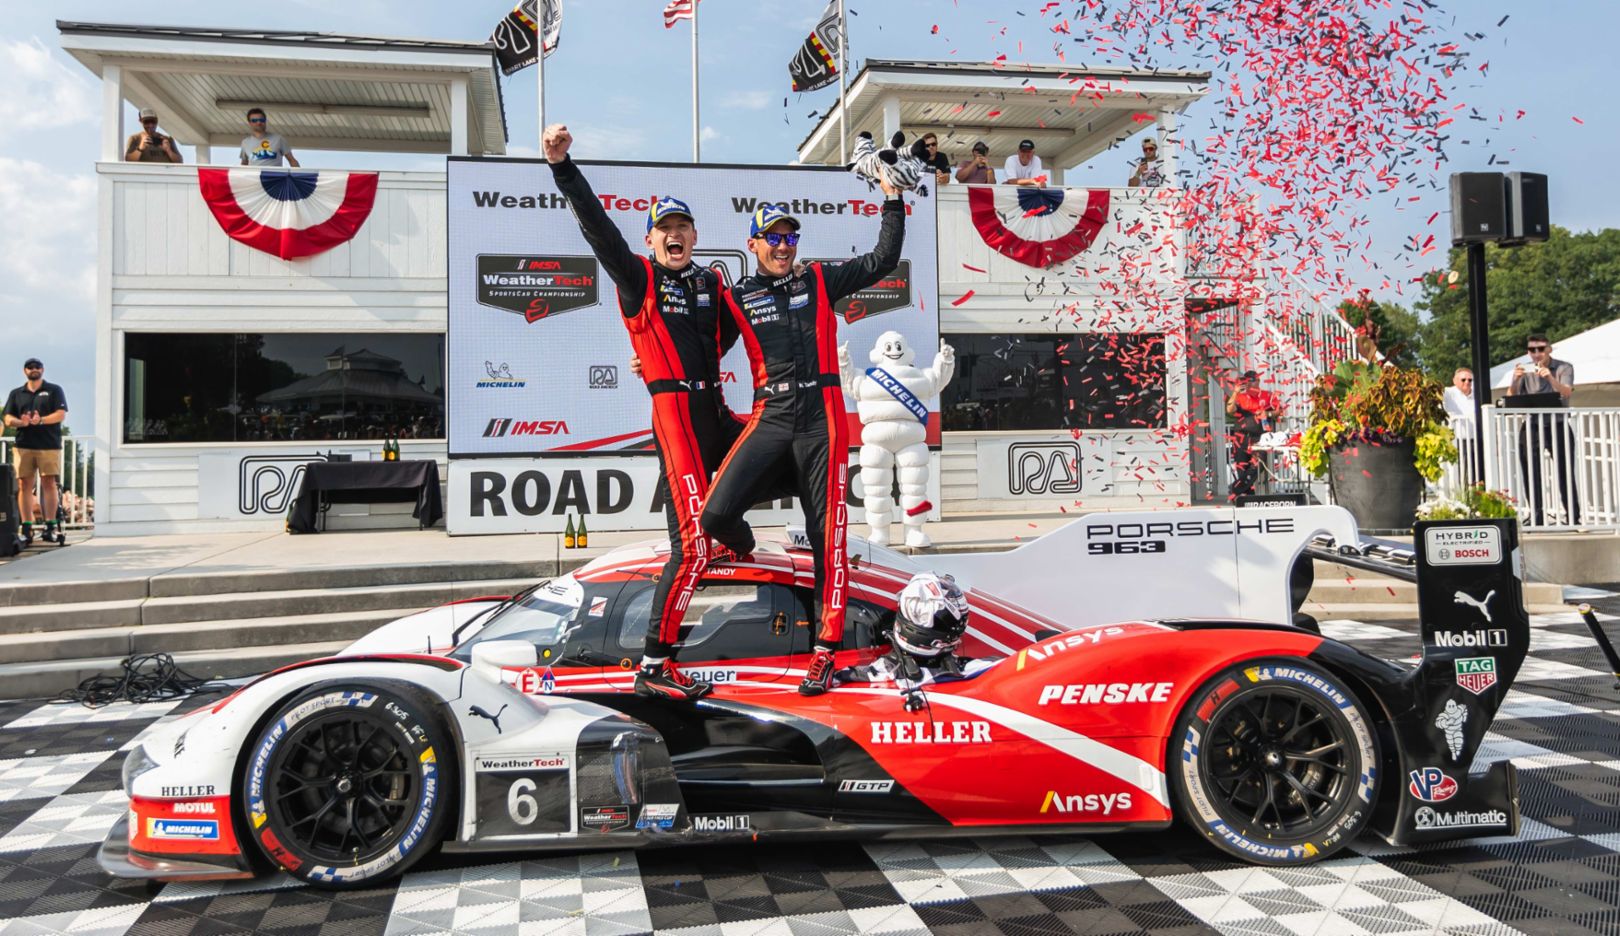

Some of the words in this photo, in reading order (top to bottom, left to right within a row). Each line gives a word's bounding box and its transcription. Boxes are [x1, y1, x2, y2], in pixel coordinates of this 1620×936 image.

[473, 191, 660, 211] WeathTec
[529, 260, 561, 270] IMSA
[483, 274, 593, 288] WeatherTech
[663, 305, 683, 314] Mobil
[750, 305, 777, 317] Ansys
[751, 314, 771, 326] Mobil
[871, 369, 927, 418] MICHELIN
[510, 420, 571, 436] IMSA
[470, 468, 635, 517] ROAD
[832, 463, 847, 609] PORSCHE
[1086, 517, 1295, 540] PORSCHE
[1435, 529, 1489, 541] HYBRID
[1087, 540, 1166, 555] 963
[1455, 549, 1489, 558] BOSCH
[707, 567, 736, 576] TANDY
[1434, 630, 1486, 647] Mobil
[1016, 625, 1124, 672] Ansys
[1459, 660, 1492, 672] TAG
[543, 681, 554, 691] N
[1273, 667, 1346, 705] MICHELIN
[1458, 673, 1495, 692] HEUER
[1038, 681, 1175, 705] PENSKE
[870, 720, 993, 744] HELLER
[251, 723, 284, 798] MICHELIN
[482, 757, 564, 769] WeatherTech
[161, 784, 216, 797] HELLER
[856, 782, 890, 791] GTP
[1409, 766, 1443, 801] VP
[173, 802, 216, 813] MOTUL
[507, 777, 539, 826] 6
[1040, 790, 1132, 815] Ansys
[403, 777, 436, 850] MICHELIN
[1437, 809, 1507, 826] Multimatic
[165, 825, 213, 834] MICHELIN
[695, 816, 734, 831] Mobil
[1214, 823, 1290, 859] MICHELIN
